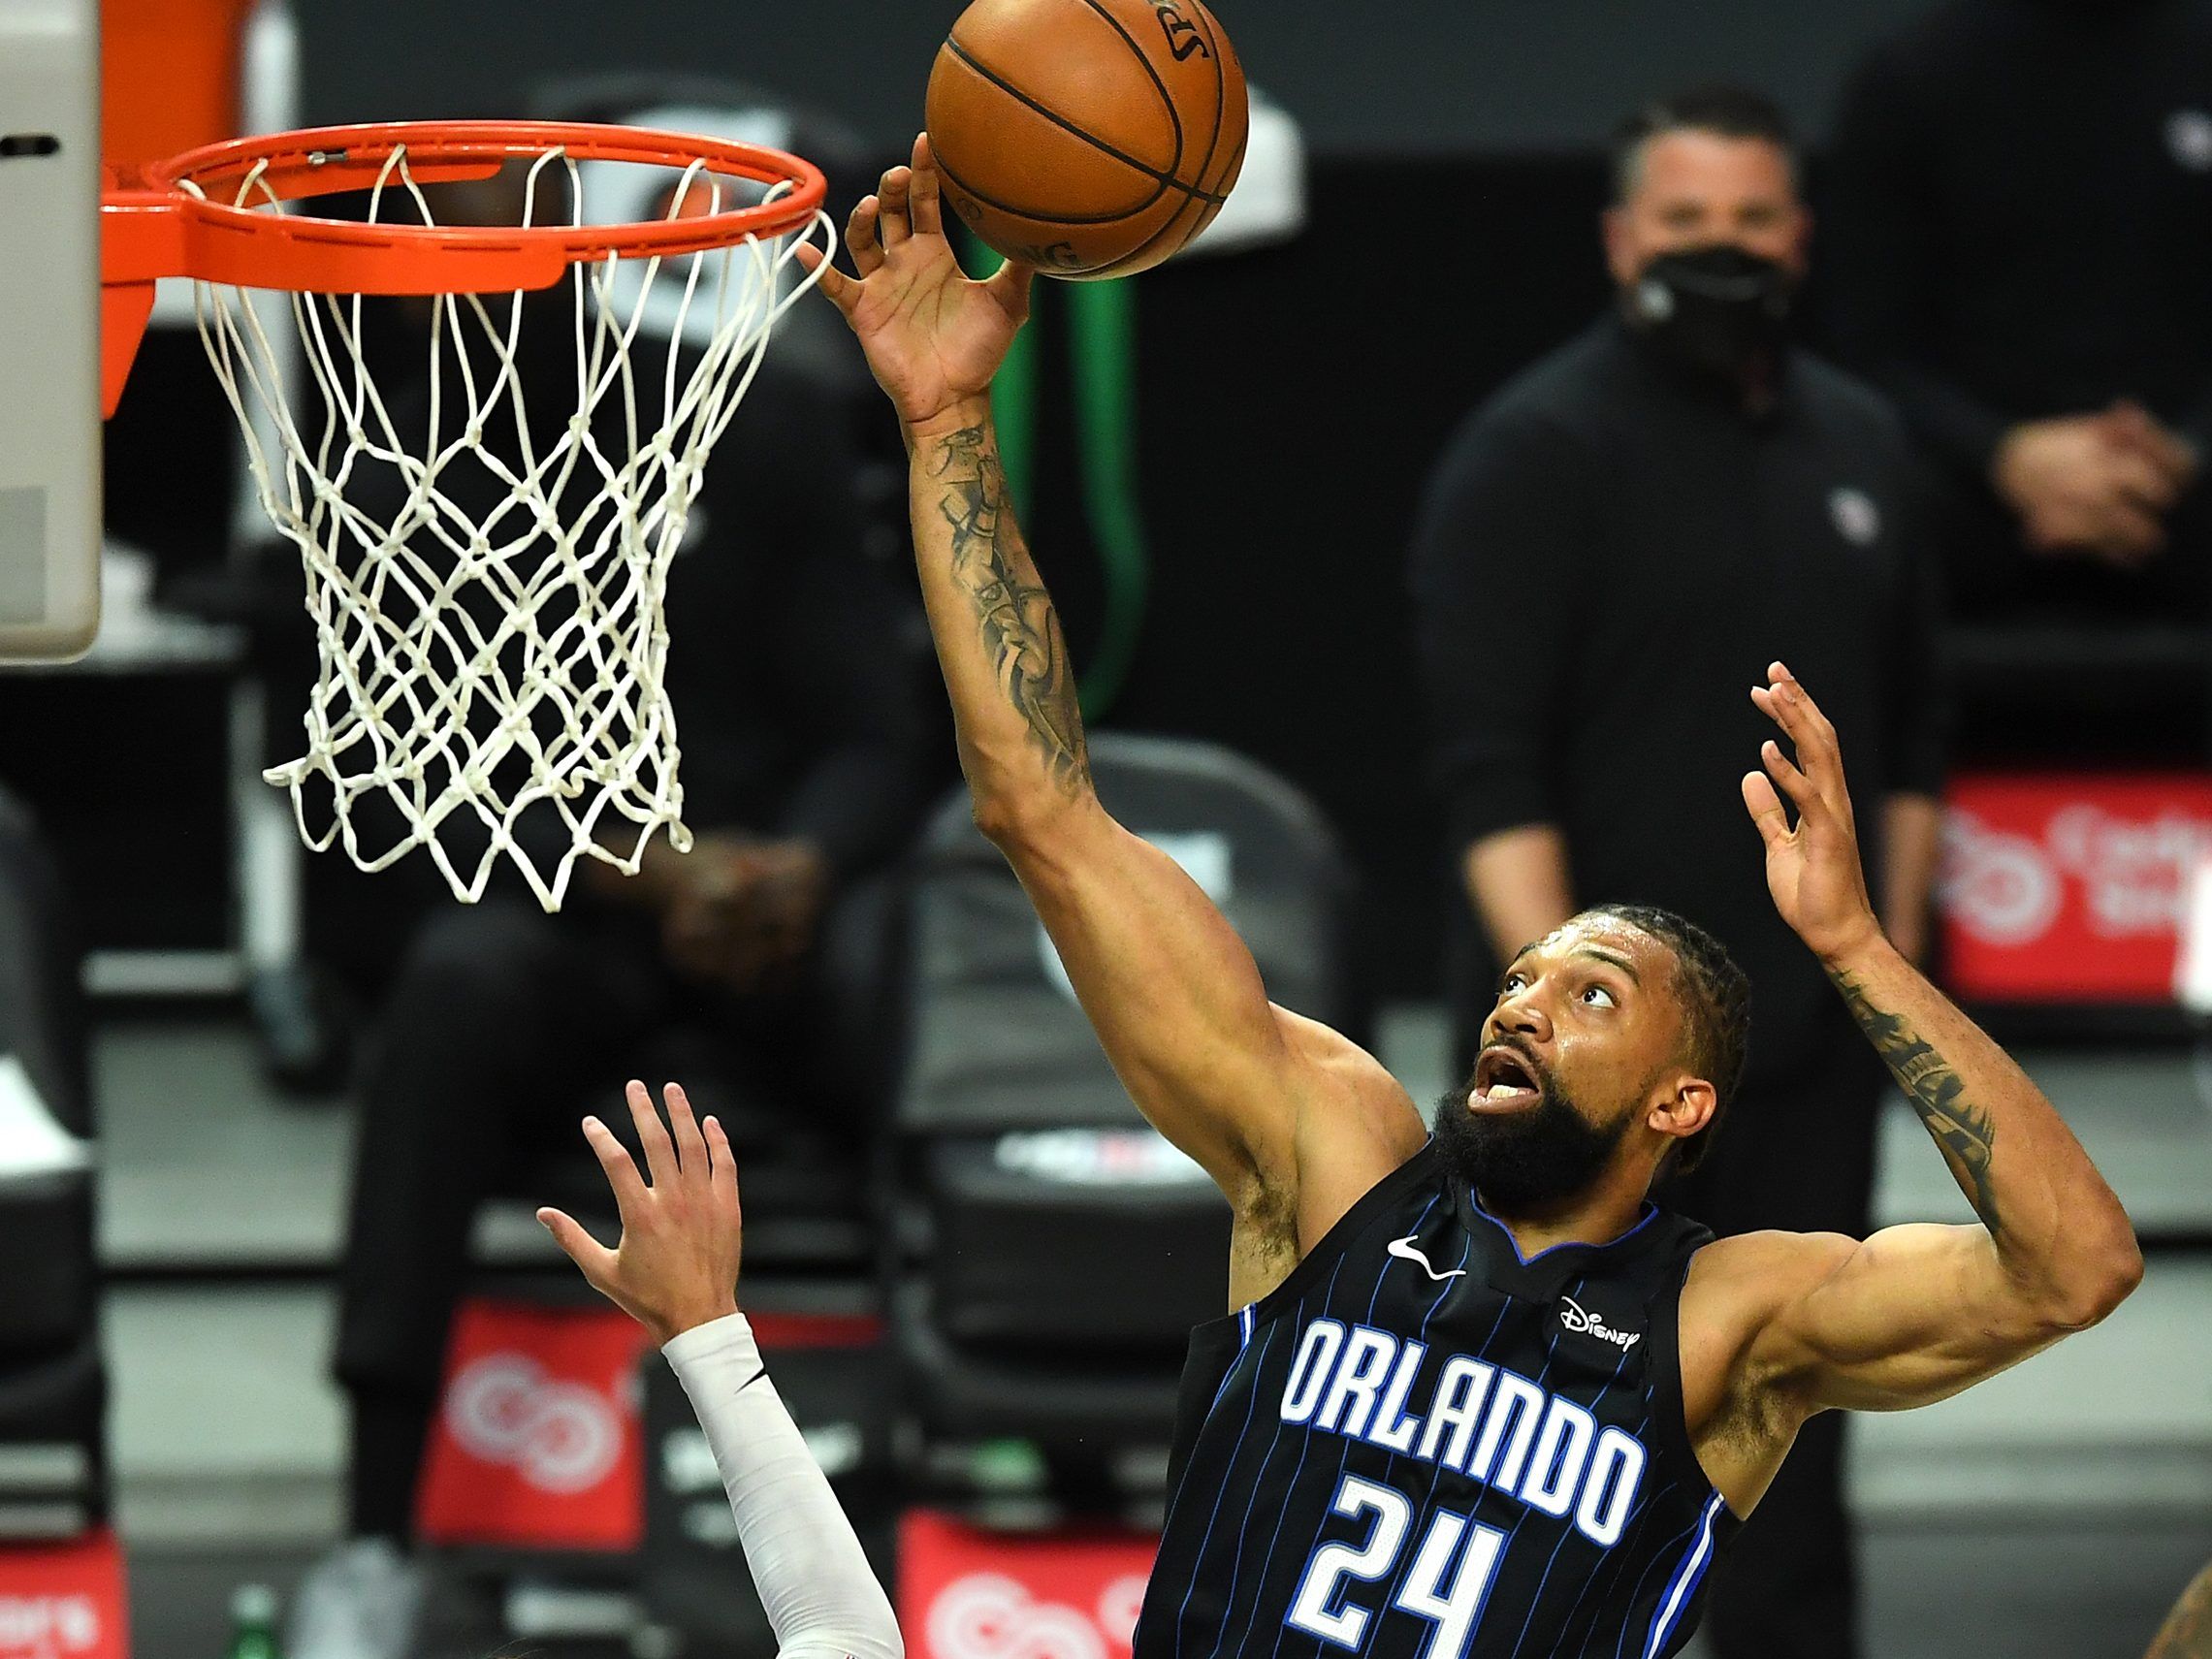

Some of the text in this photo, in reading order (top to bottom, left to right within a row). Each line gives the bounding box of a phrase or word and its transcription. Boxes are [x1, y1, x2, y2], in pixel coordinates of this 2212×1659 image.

[1150, 0, 1210, 62] SP
[1279, 1317, 1648, 1547] ORLANDO
[1283, 1471, 1510, 1659] 24
